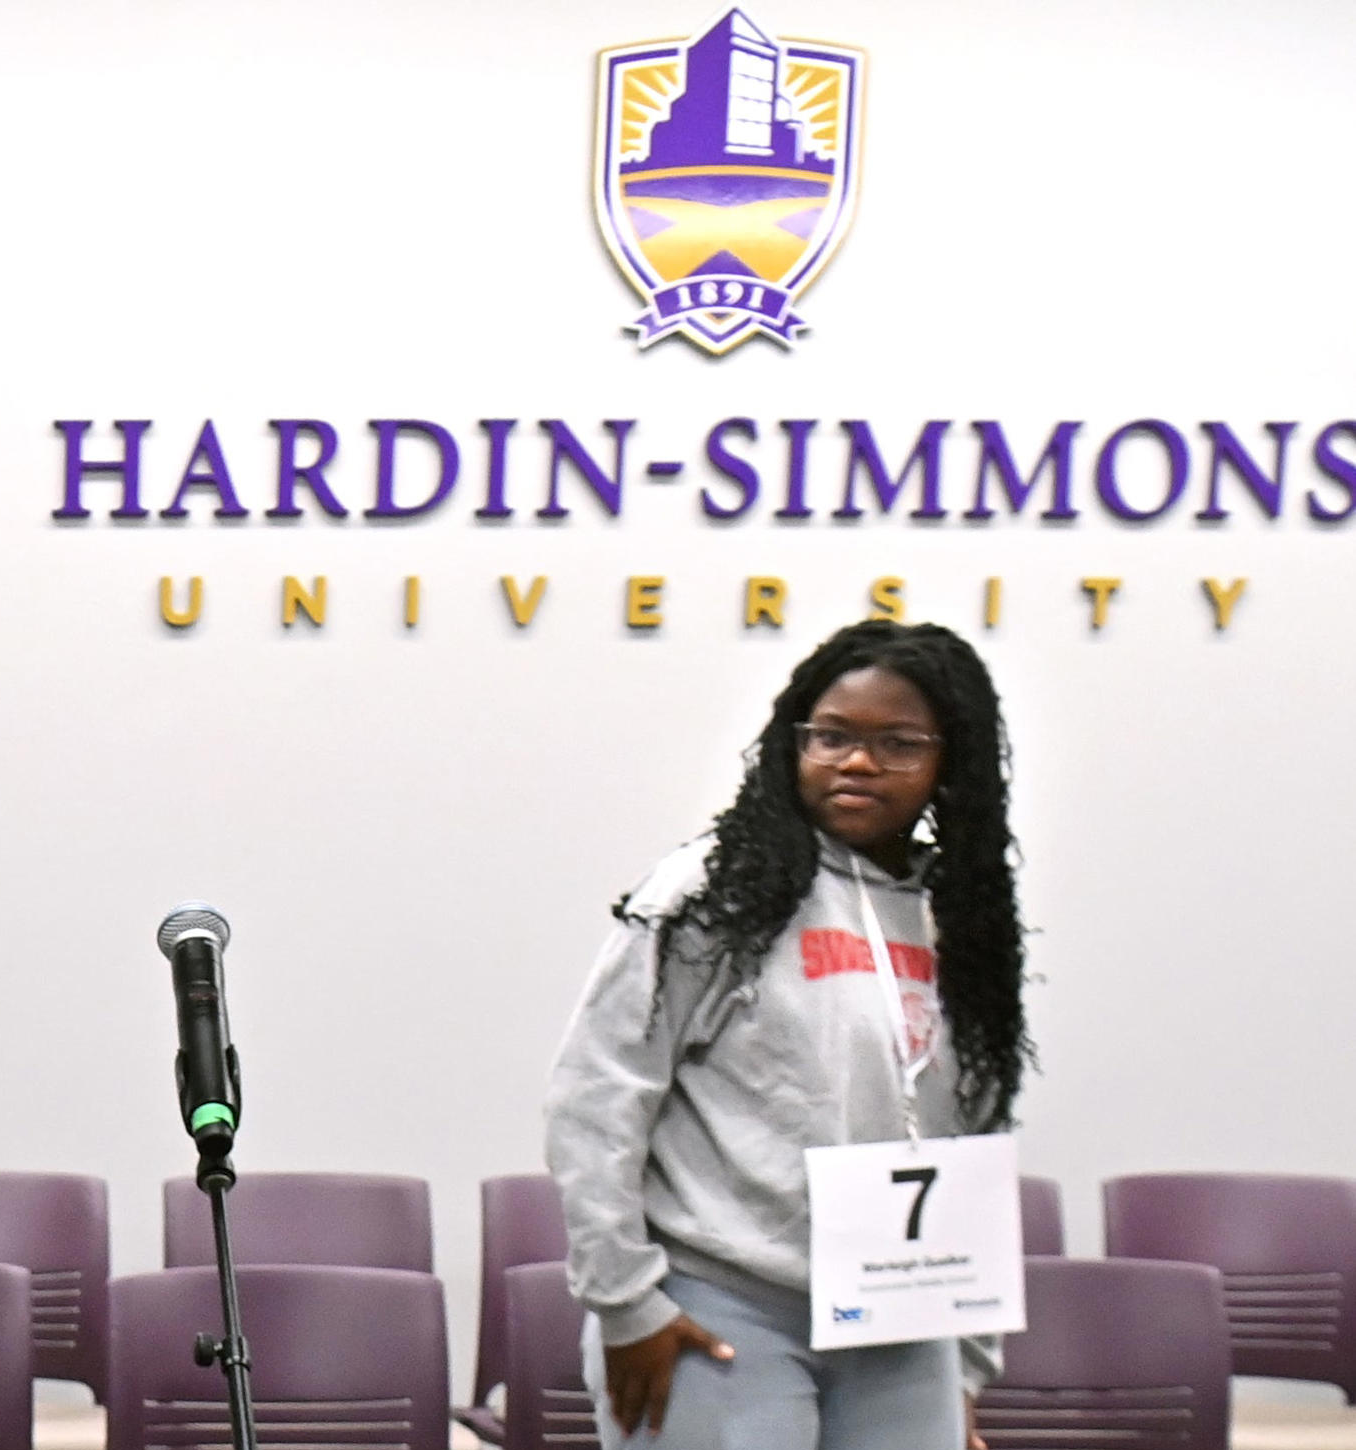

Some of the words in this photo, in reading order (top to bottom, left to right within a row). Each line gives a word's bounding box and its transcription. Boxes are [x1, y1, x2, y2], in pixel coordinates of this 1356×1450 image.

[677, 280, 764, 310] 1891
[52, 418, 1356, 521] HARDIN-SIMMONS
[158, 574, 1246, 627] UNIVERSITY
[891, 1166, 937, 1240] 7
